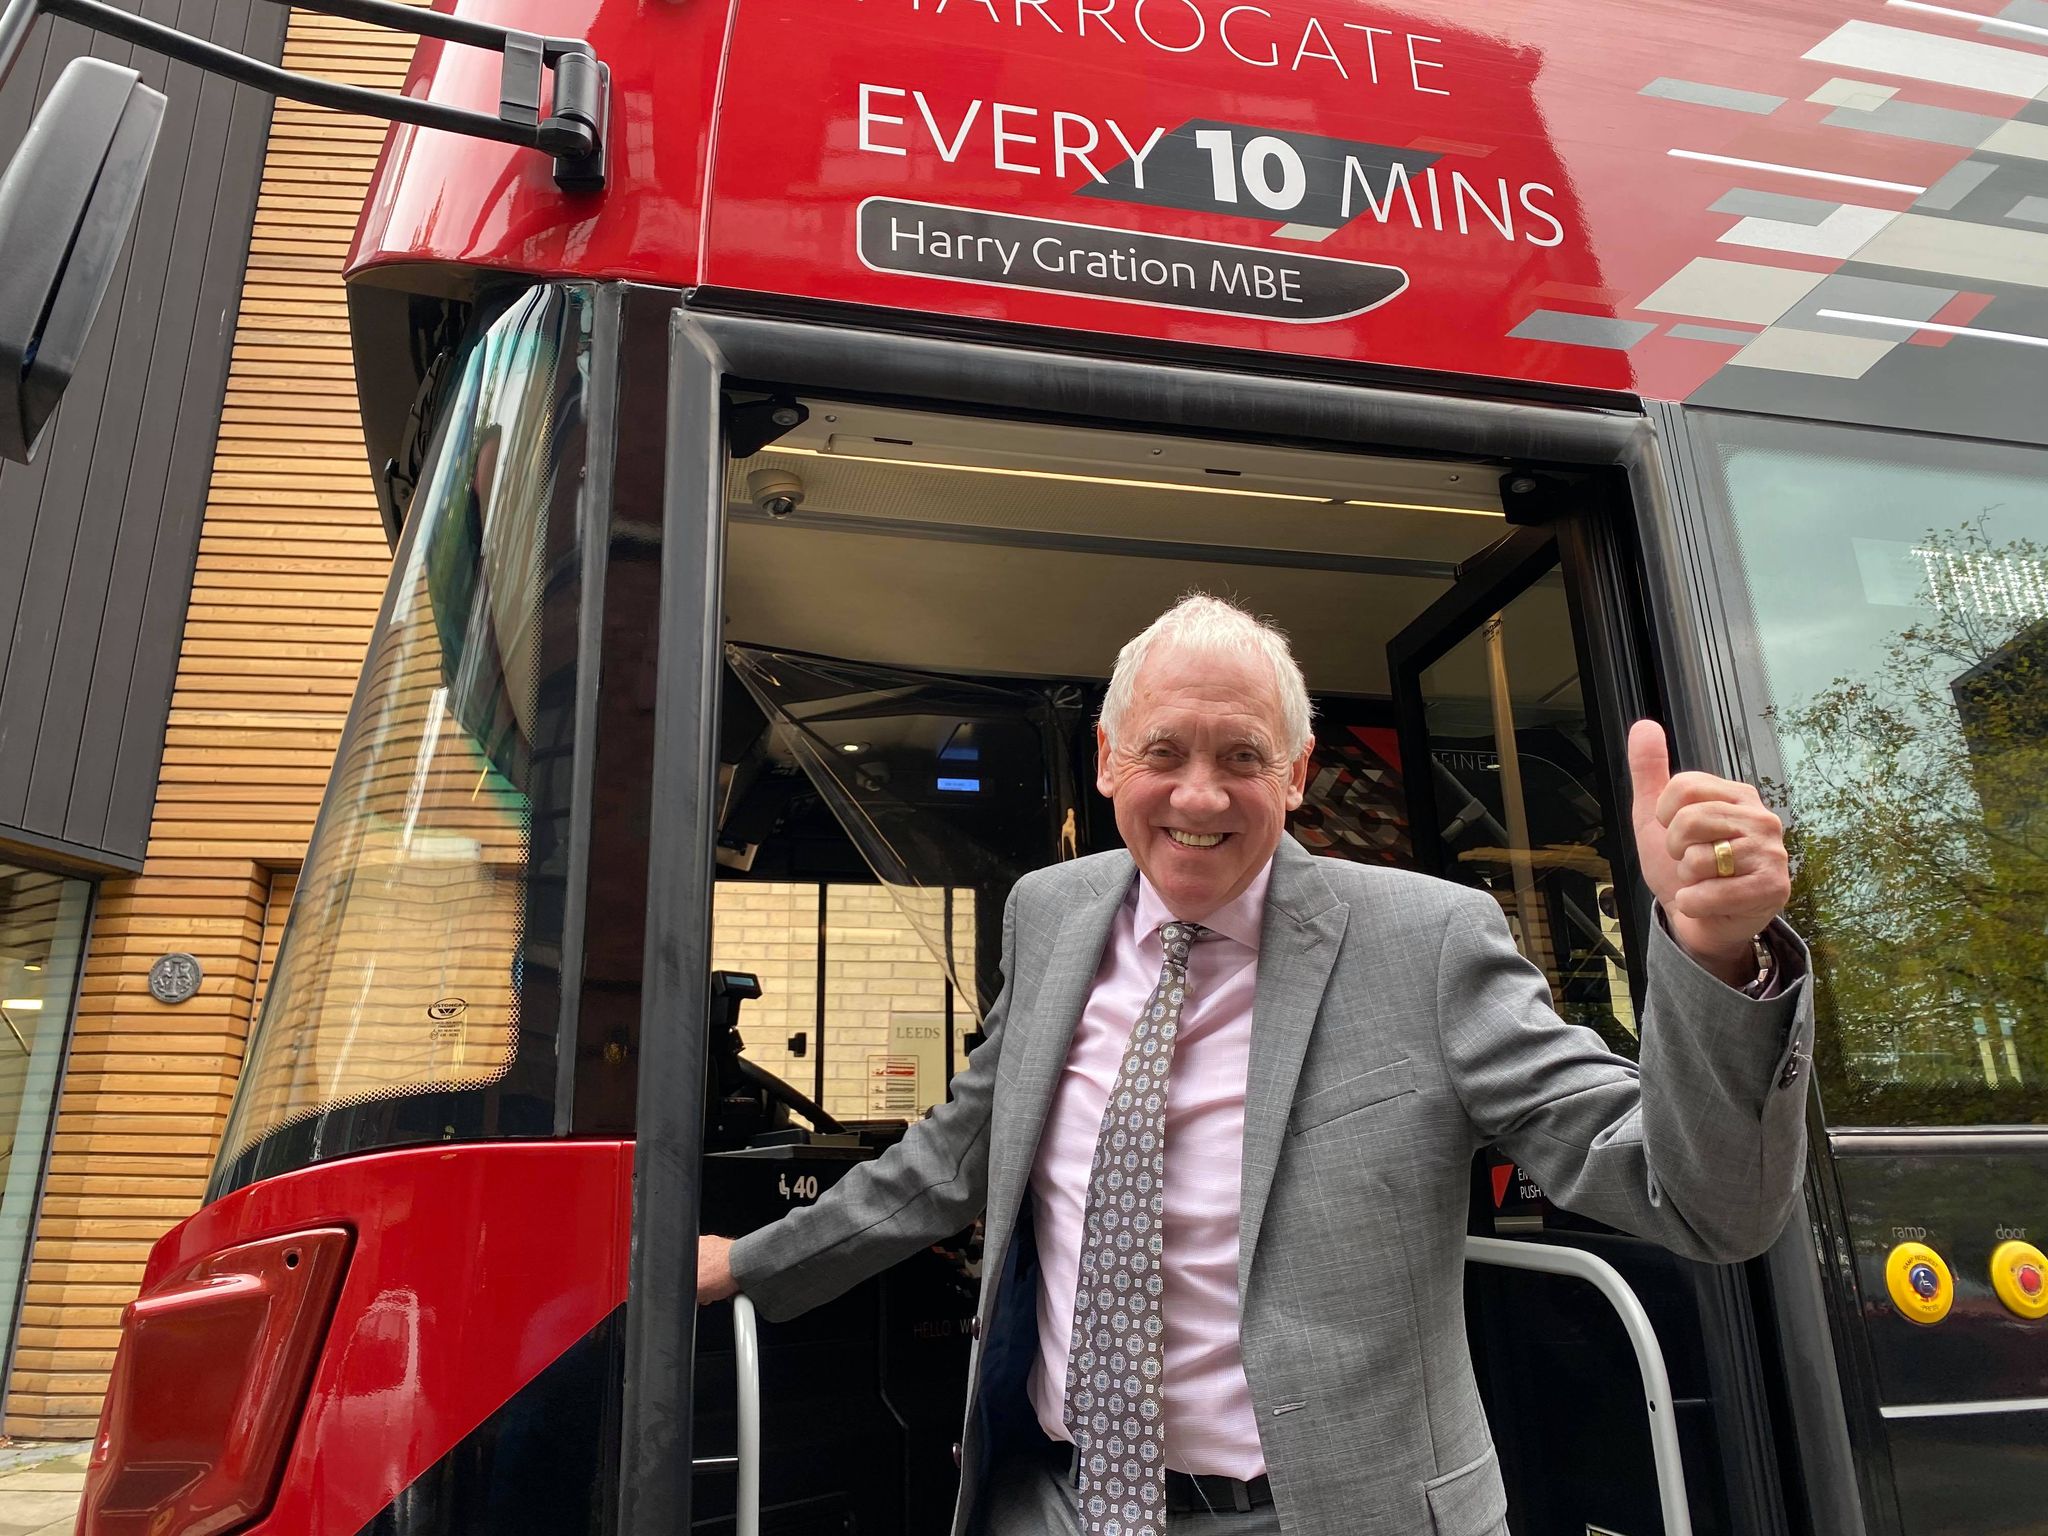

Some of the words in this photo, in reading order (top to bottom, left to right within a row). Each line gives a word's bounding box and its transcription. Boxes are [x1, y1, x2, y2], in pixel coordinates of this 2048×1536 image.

[859, 0, 1450, 96] ROGATE
[859, 83, 1167, 190] EVERY
[1195, 129, 1307, 211] 10
[1340, 155, 1564, 247] MINS
[890, 216, 1021, 275] Harry
[1032, 237, 1197, 290] Gration
[1209, 259, 1303, 303] MBE
[1910, 549, 2048, 620] THAN
[895, 1026, 941, 1039] LEEDS
[792, 1175, 818, 1199] 40
[1519, 1184, 1542, 1199] PUSH
[1892, 1226, 1927, 1241] ramp
[1995, 1223, 2027, 1240] door
